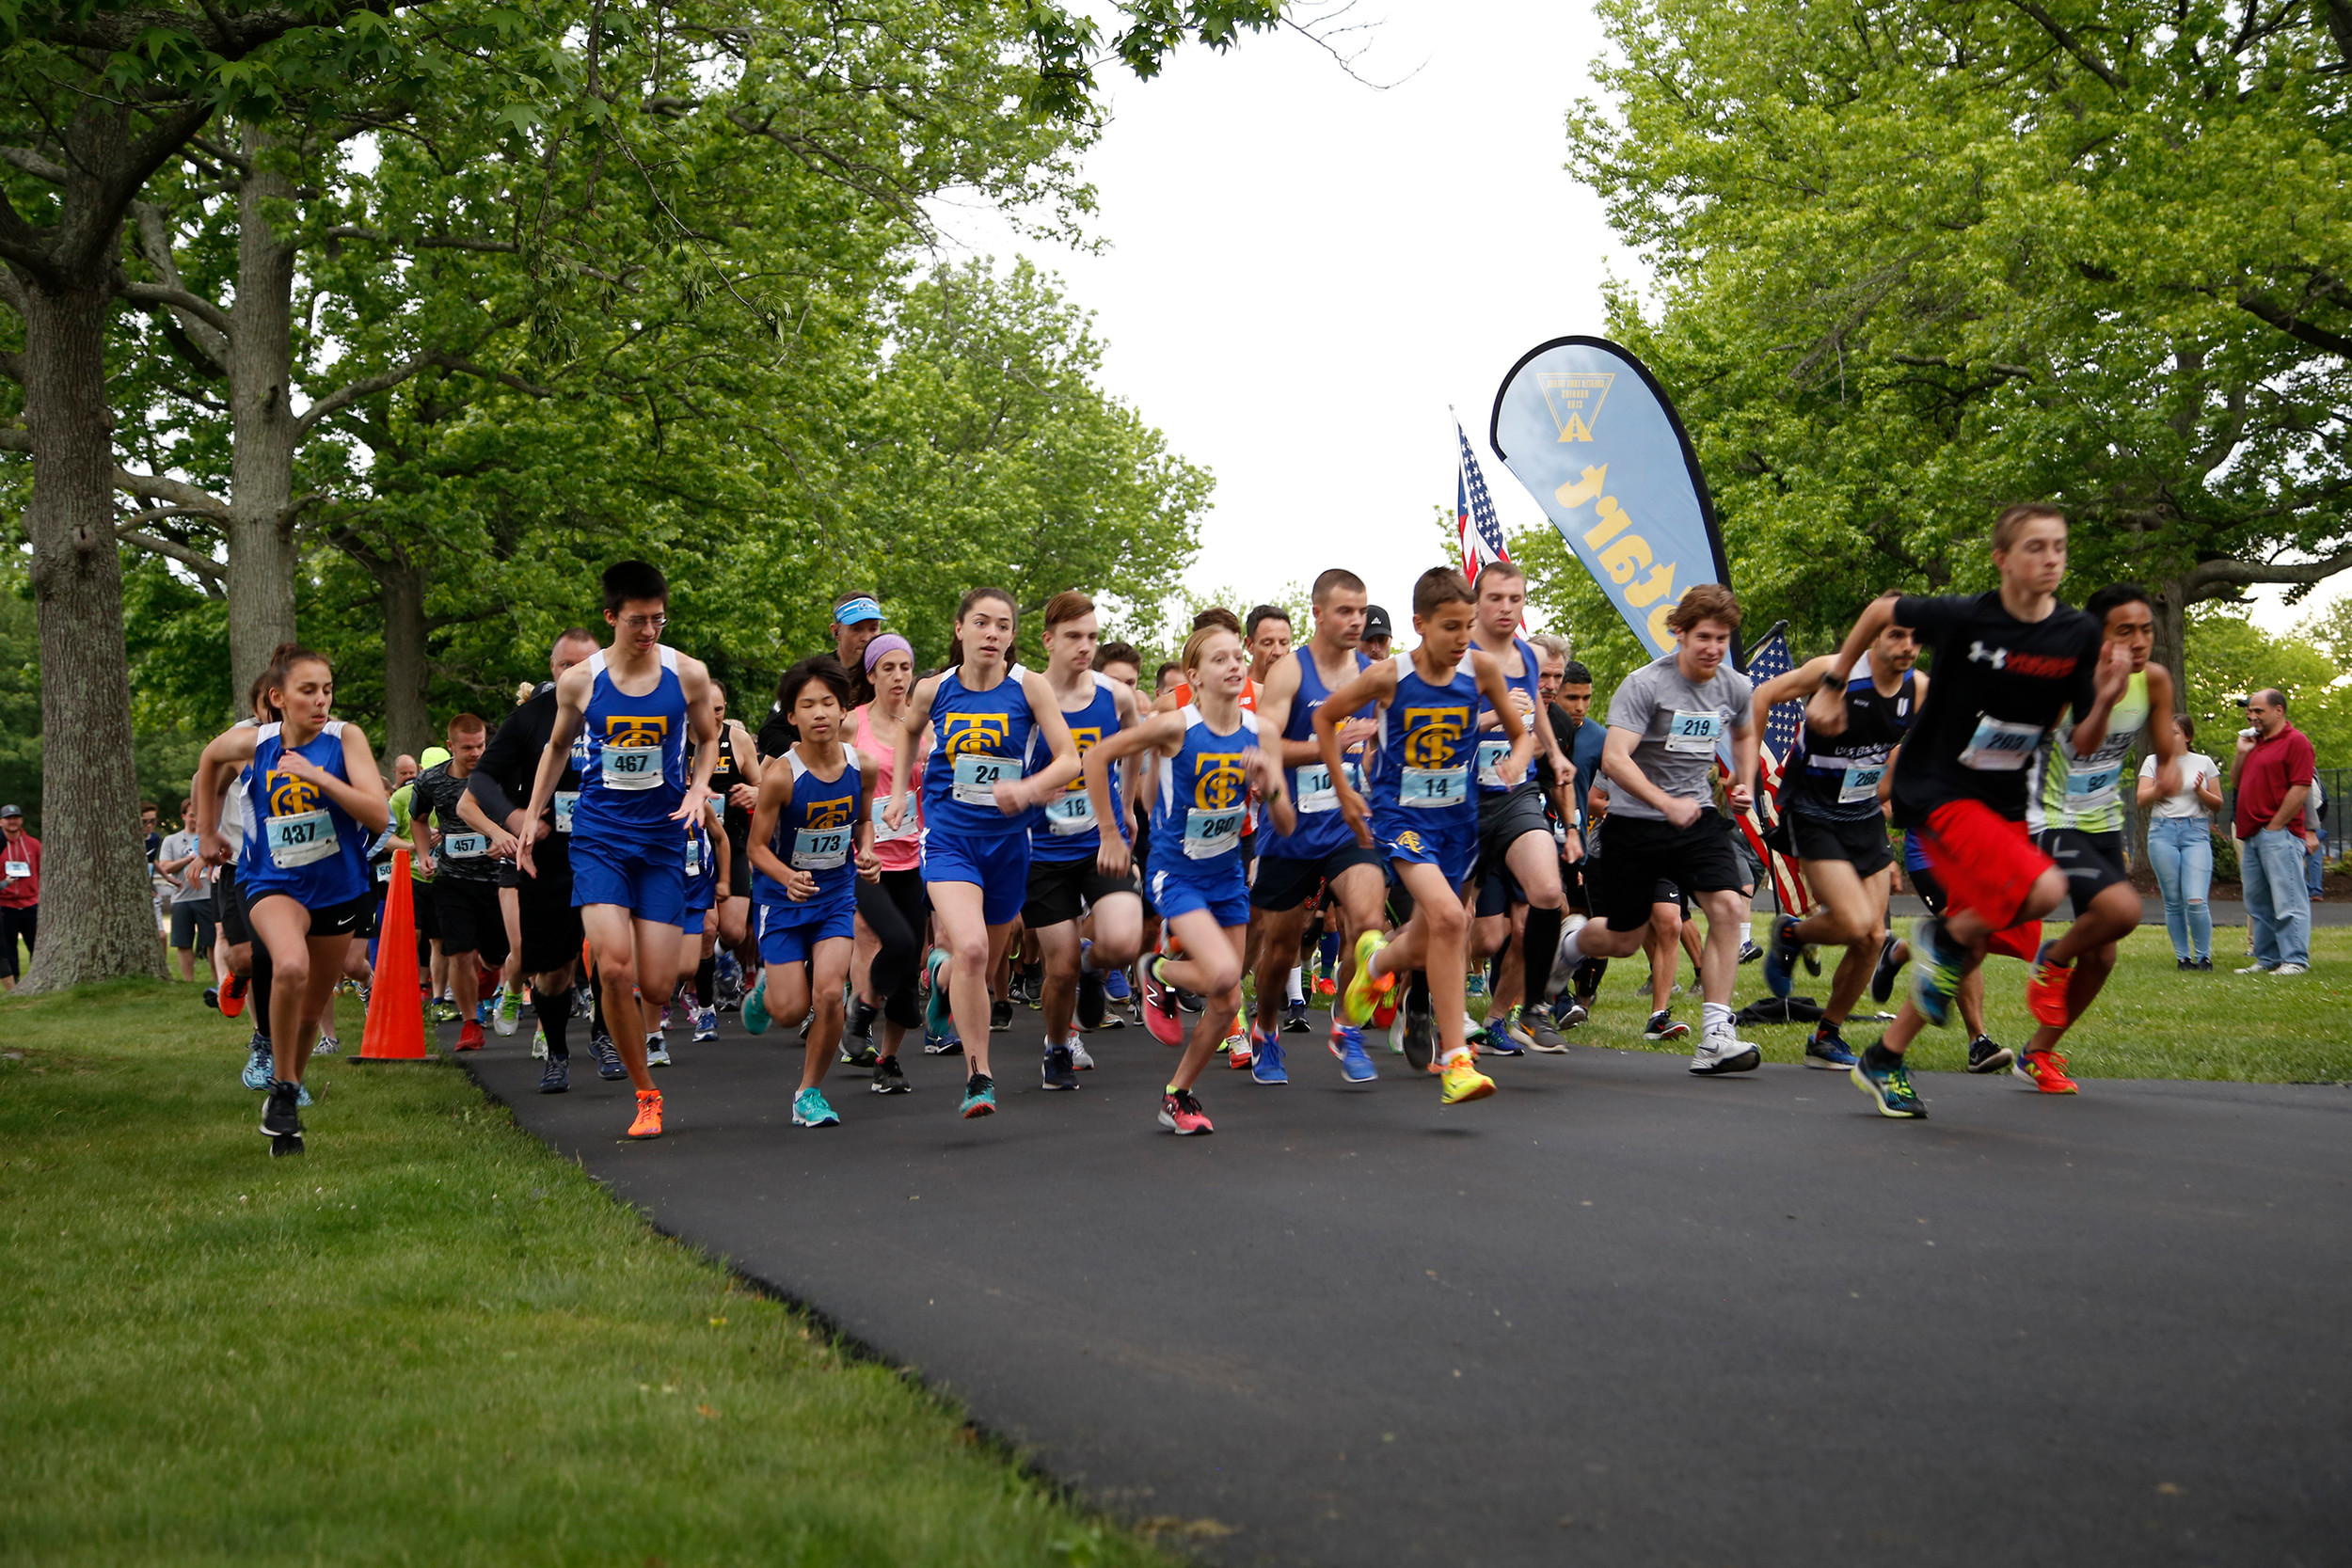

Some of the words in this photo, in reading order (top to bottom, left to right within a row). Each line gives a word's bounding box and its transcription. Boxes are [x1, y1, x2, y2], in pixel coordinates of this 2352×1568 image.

[1683, 720, 1710, 736] 219
[614, 755, 648, 772] 467
[975, 765, 999, 784] 24
[2088, 774, 2107, 793] 92
[1424, 778, 1449, 797] 14
[281, 822, 316, 846] 437
[1201, 816, 1236, 837] 260
[453, 839, 476, 852] 457
[811, 835, 842, 853] 173
